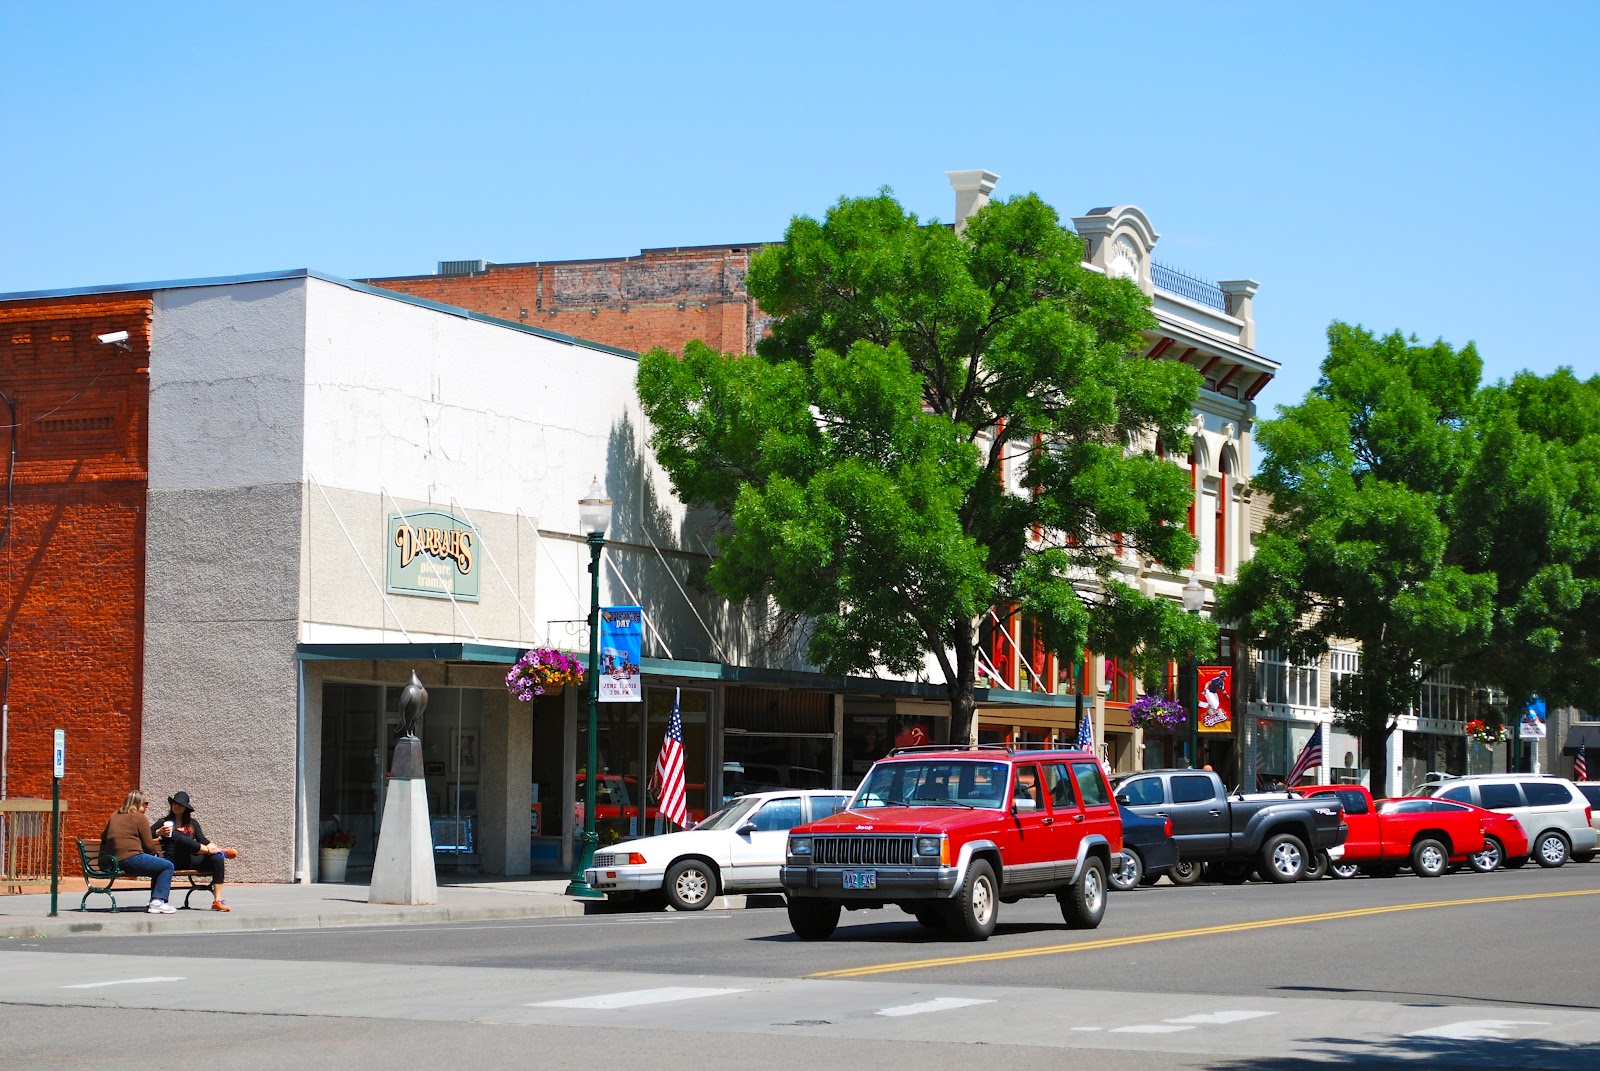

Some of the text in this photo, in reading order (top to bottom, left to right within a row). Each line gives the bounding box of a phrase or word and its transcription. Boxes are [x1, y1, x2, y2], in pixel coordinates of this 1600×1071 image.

[420, 561, 451, 575] picture
[417, 574, 453, 591] framing
[616, 619, 630, 629] DAY
